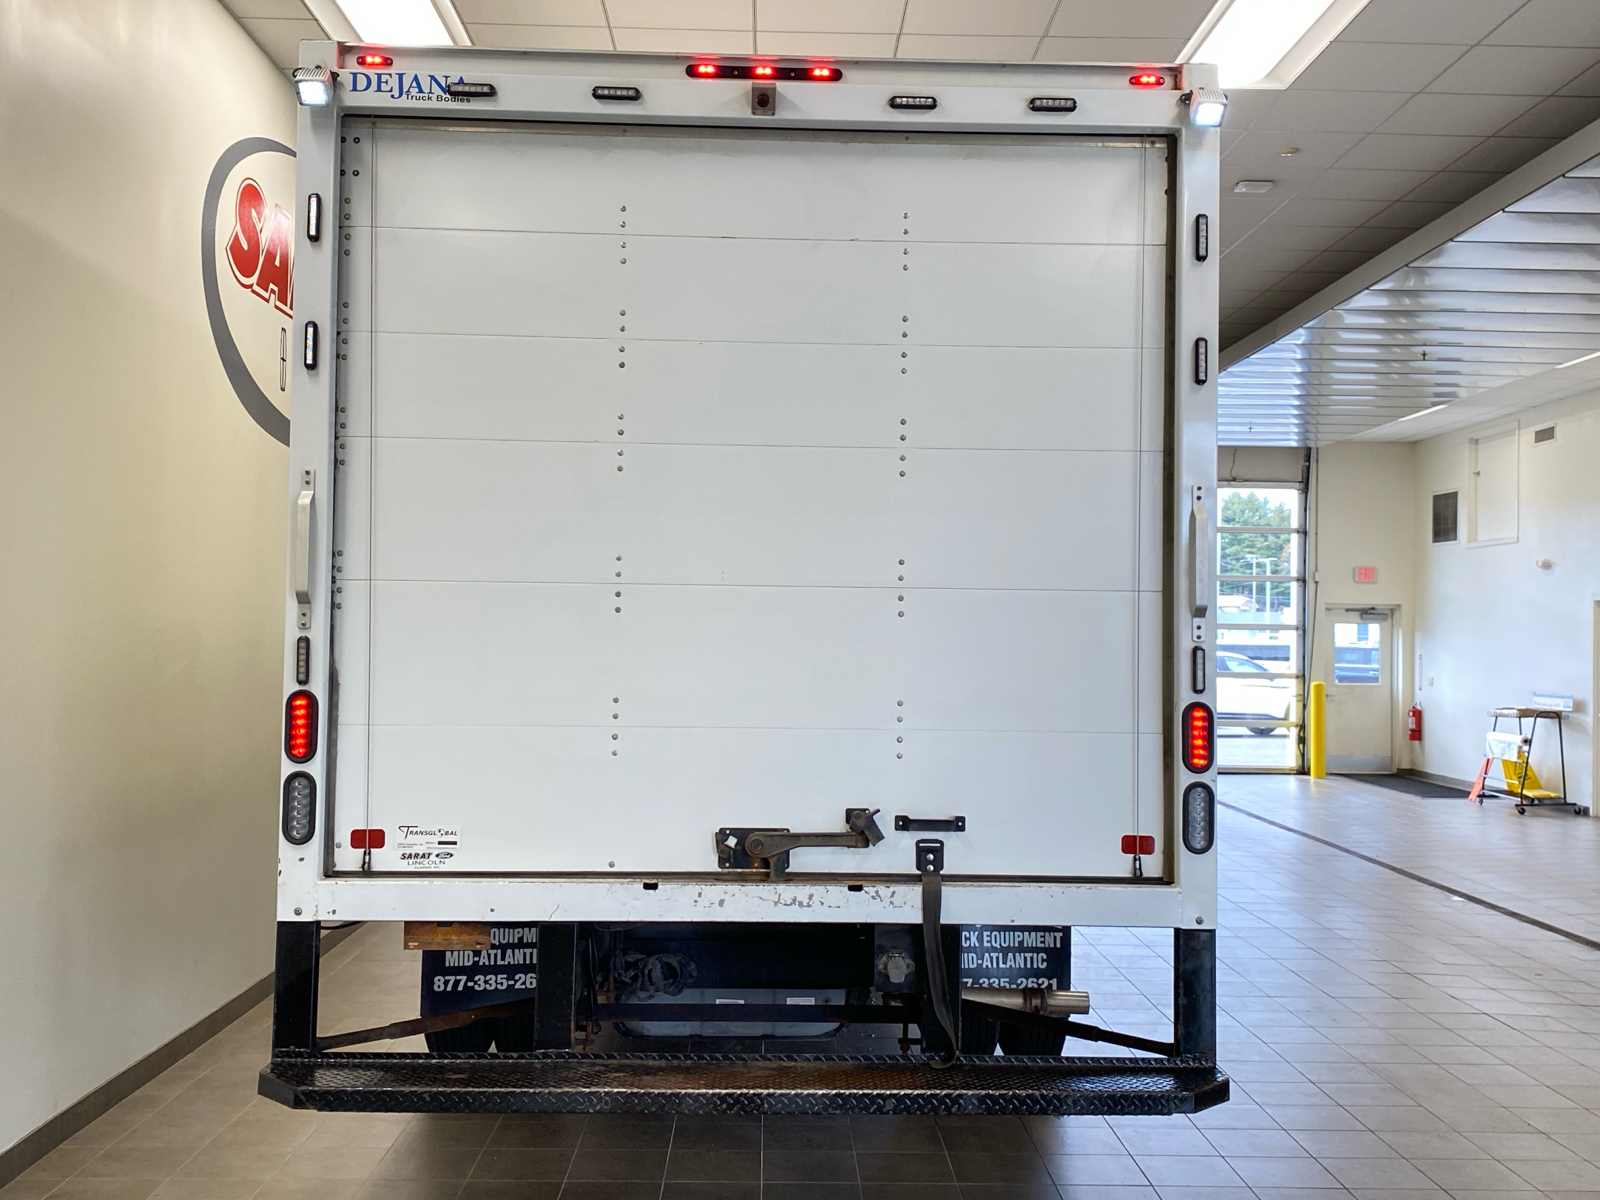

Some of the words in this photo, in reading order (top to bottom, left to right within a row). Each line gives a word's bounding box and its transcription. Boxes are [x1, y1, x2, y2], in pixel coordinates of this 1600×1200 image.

[405, 93, 433, 102] Truck
[436, 94, 471, 103] Bodies
[225, 177, 295, 320] SA
[1358, 566, 1376, 581] EXIT
[400, 852, 433, 860] SARAT
[490, 927, 538, 946] QUIPM
[962, 931, 979, 947] CK
[983, 931, 1063, 949] EQUIPMENT
[445, 948, 537, 967] MID-ATLANTI
[962, 952, 1047, 969] ID-ATLANTIC
[433, 973, 537, 992] 877-335-26
[963, 977, 1058, 990] 7-335-2621
